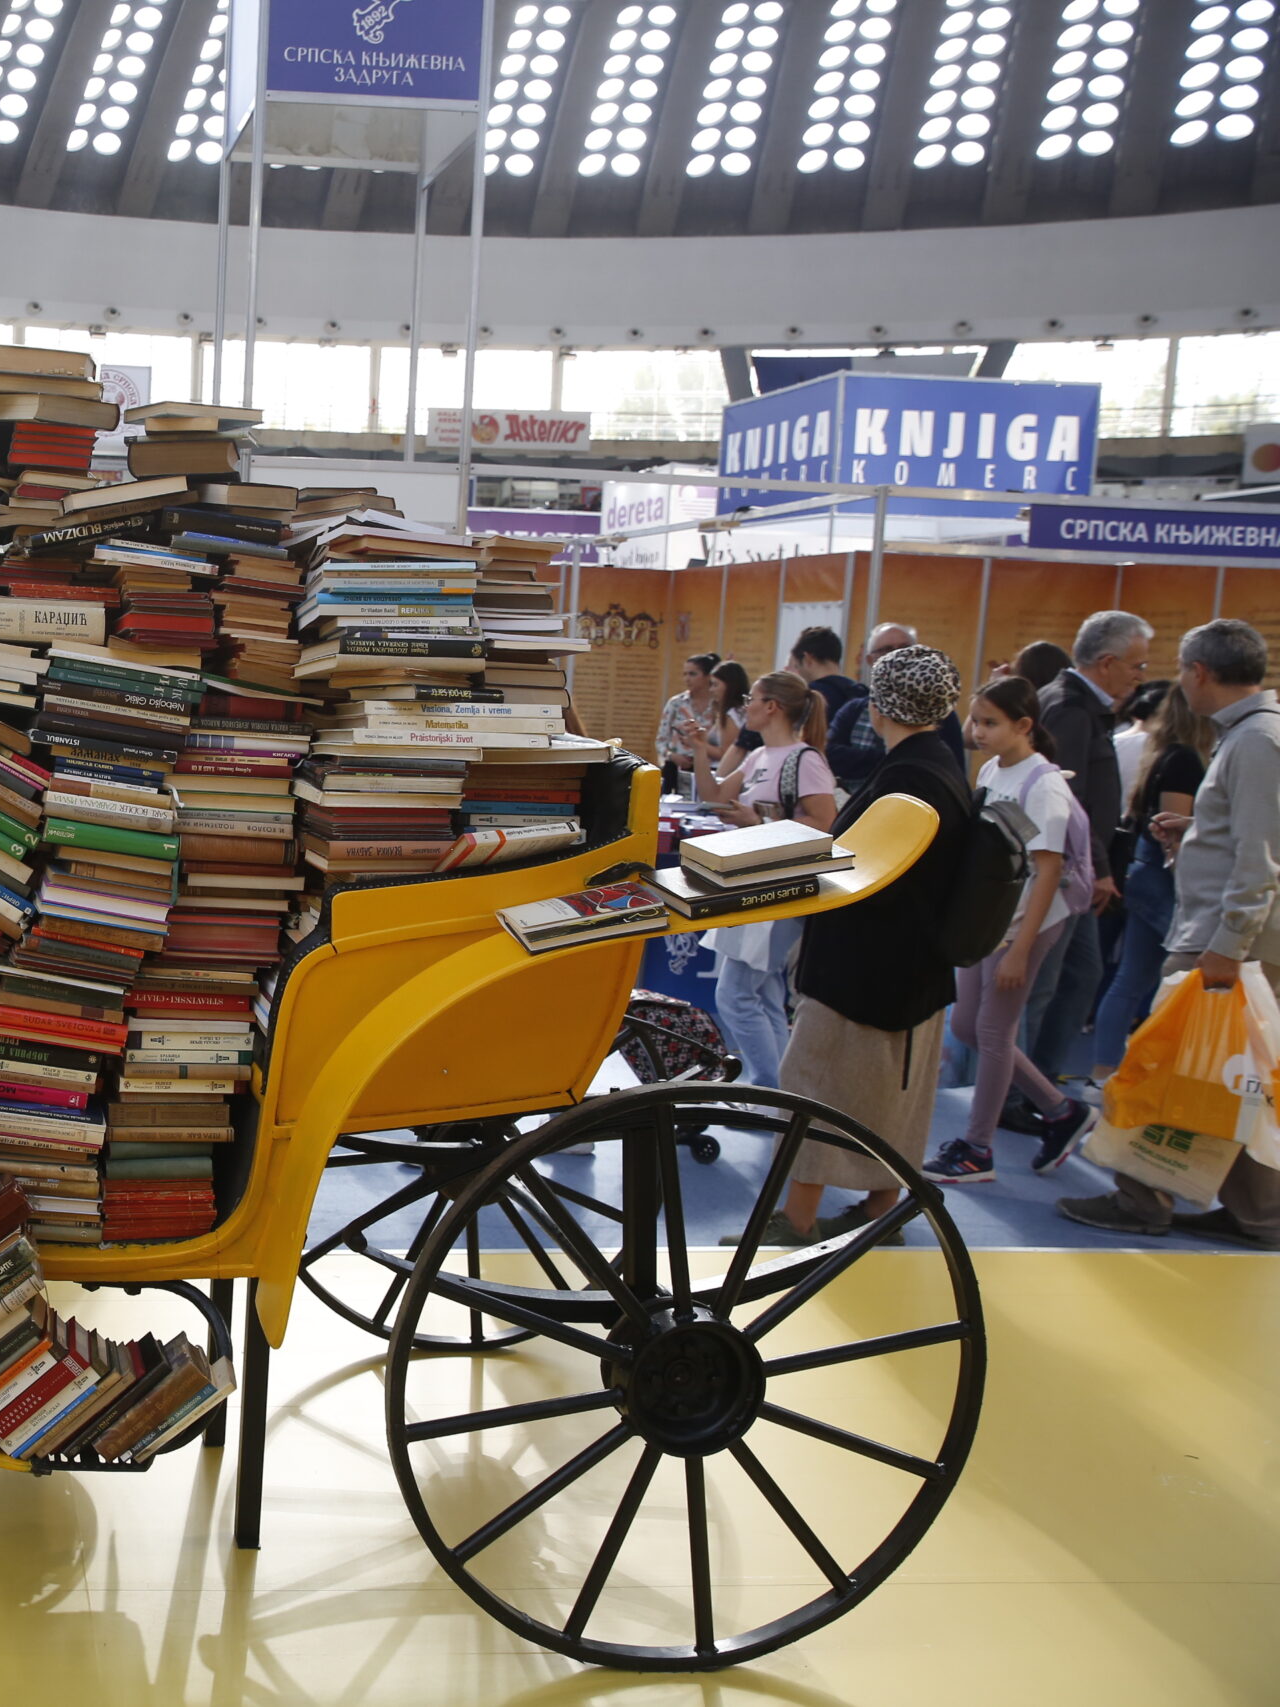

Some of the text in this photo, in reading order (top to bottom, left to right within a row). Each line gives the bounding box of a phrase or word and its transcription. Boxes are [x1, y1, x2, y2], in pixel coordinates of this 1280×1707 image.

[284, 46, 466, 72] СРПСКА КЊИЖЕВНА
[334, 67, 414, 87] ЗАДРУГА
[503, 414, 587, 445] Asteriks
[854, 407, 1080, 463] KNJIGA
[726, 409, 830, 475] KNJIGA
[852, 459, 1078, 491] KOMERC
[607, 496, 664, 528] dereta
[41, 524, 102, 543] BUDIZAM
[1060, 517, 1148, 542] СРПСКА
[33, 610, 88, 627] КАРАЏИЋ
[149, 696, 185, 712] Nebojša
[421, 704, 452, 715] Vasiona,
[455, 703, 480, 715] Zemlja
[488, 706, 512, 715] vreme
[425, 719, 469, 730] Matematika
[46, 734, 80, 746] ISTANBUL
[410, 732, 474, 744] Praistorijski život
[139, 749, 153, 757] Orhan
[741, 885, 801, 907] žan-pol sartr
[170, 995, 223, 1005] STRAVINSKI
[23, 1015, 96, 1033] SUDAR SVETOVA
